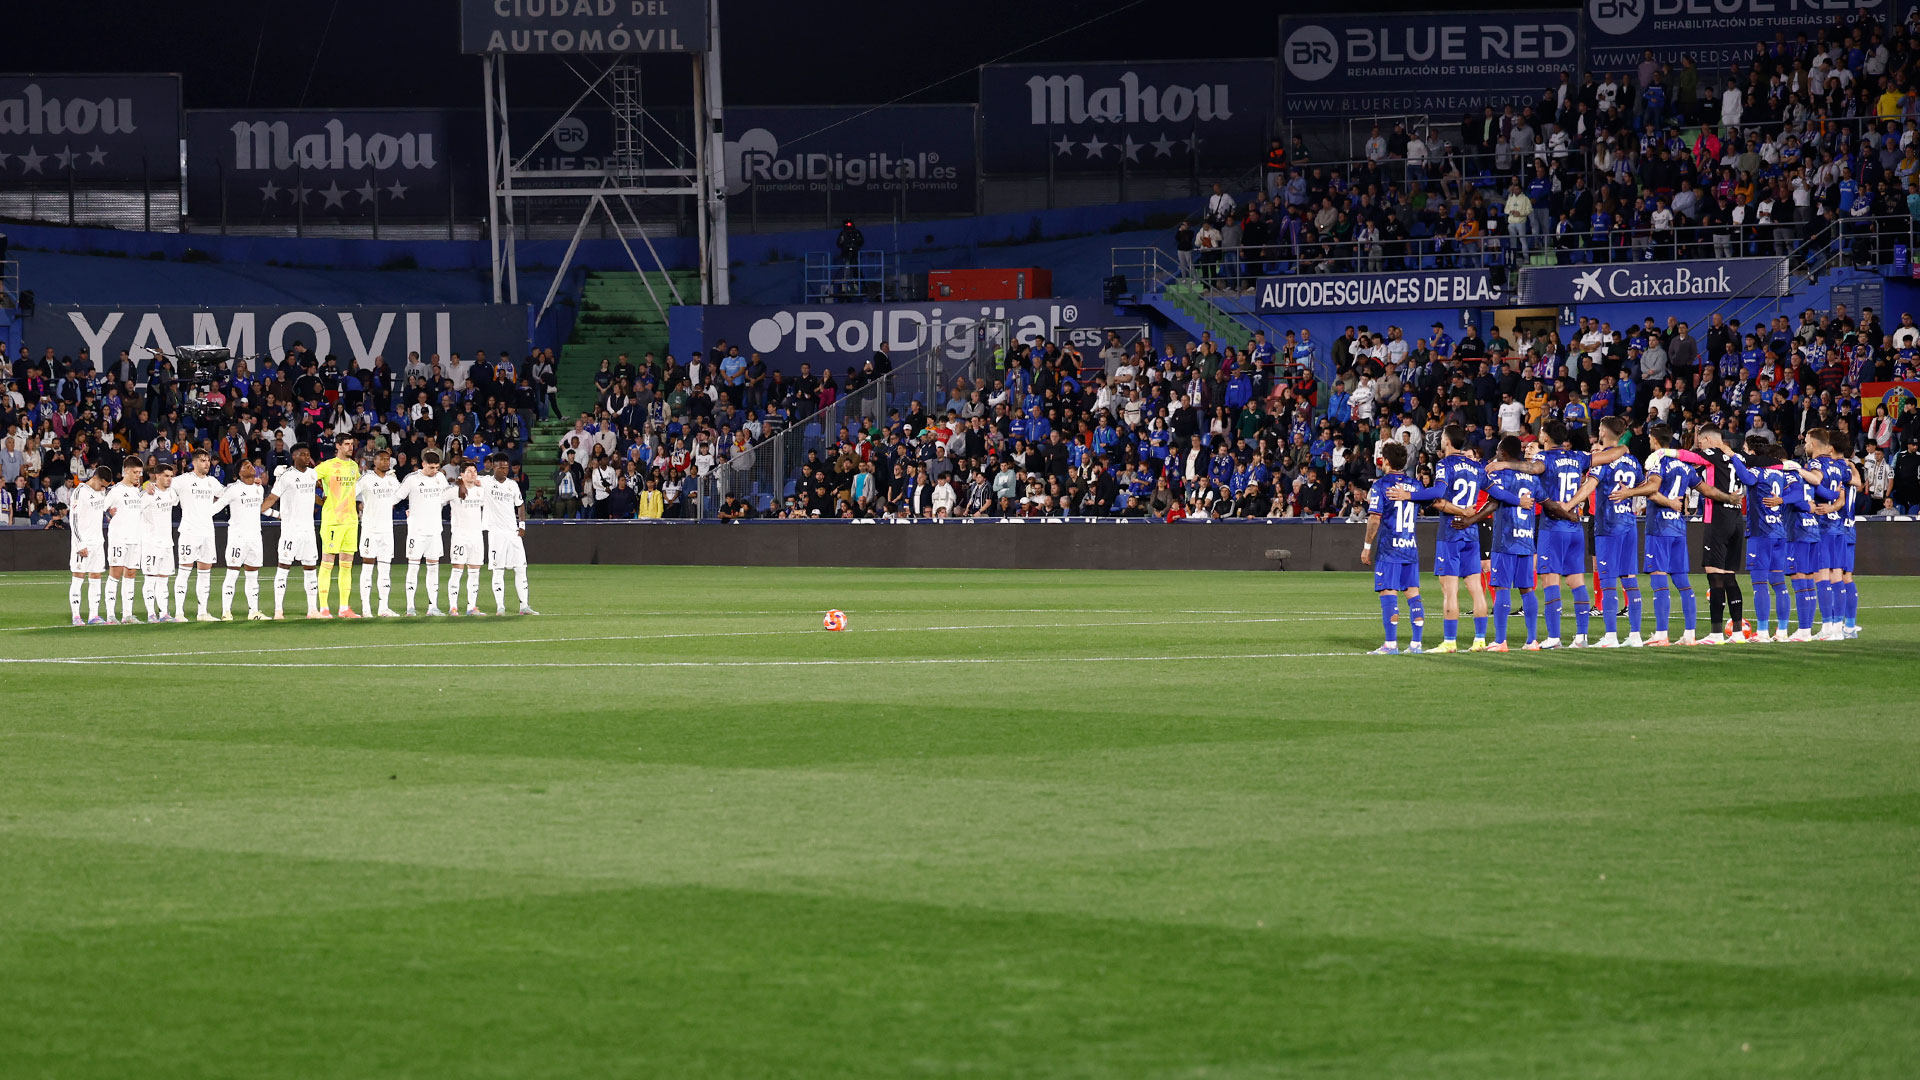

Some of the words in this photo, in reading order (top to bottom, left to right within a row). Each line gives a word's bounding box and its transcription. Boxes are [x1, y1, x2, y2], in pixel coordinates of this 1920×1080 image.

[493, 0, 616, 17] CIUDAD
[631, 1, 669, 16] DEL
[1654, 17, 1746, 30] REHABILITACIÓN
[1749, 17, 1764, 26] DE
[1766, 13, 1823, 26] TUBERÍAS
[1846, 14, 1886, 24] OAS
[487, 22, 684, 51] AUTOMÓVIL
[1346, 26, 1467, 63] BLUE
[1480, 24, 1576, 60] RED
[1291, 41, 1333, 65] BR
[1347, 65, 1439, 77] REHABILITACIÓN
[1441, 66, 1456, 75] DE
[1459, 63, 1514, 75] TUBERÍAS
[1515, 64, 1534, 74] SIN
[1536, 63, 1575, 73] OBRAS
[1025, 71, 1234, 125] Mahou
[558, 127, 584, 142] BR
[229, 118, 438, 170] Mahou
[754, 181, 805, 193] mpresión
[810, 182, 844, 193] Digtal
[912, 180, 958, 191] Formato
[1608, 266, 1732, 297] CaixaBank
[1261, 277, 1420, 309] AUTODESGUACES
[1424, 276, 1449, 302] DE
[67, 311, 475, 374] YAMOVIL
[1452, 478, 1477, 509] 21
[1557, 472, 1580, 503] 15
[1393, 501, 1415, 533] 14
[181, 544, 192, 556] 35
[283, 540, 293, 551] 14
[363, 537, 370, 549] 4
[409, 538, 415, 549] 8
[453, 545, 465, 556] 20
[112, 546, 122, 558] 15
[146, 555, 156, 566] 21
[231, 547, 241, 558] 16
[491, 550, 497, 561] 7
